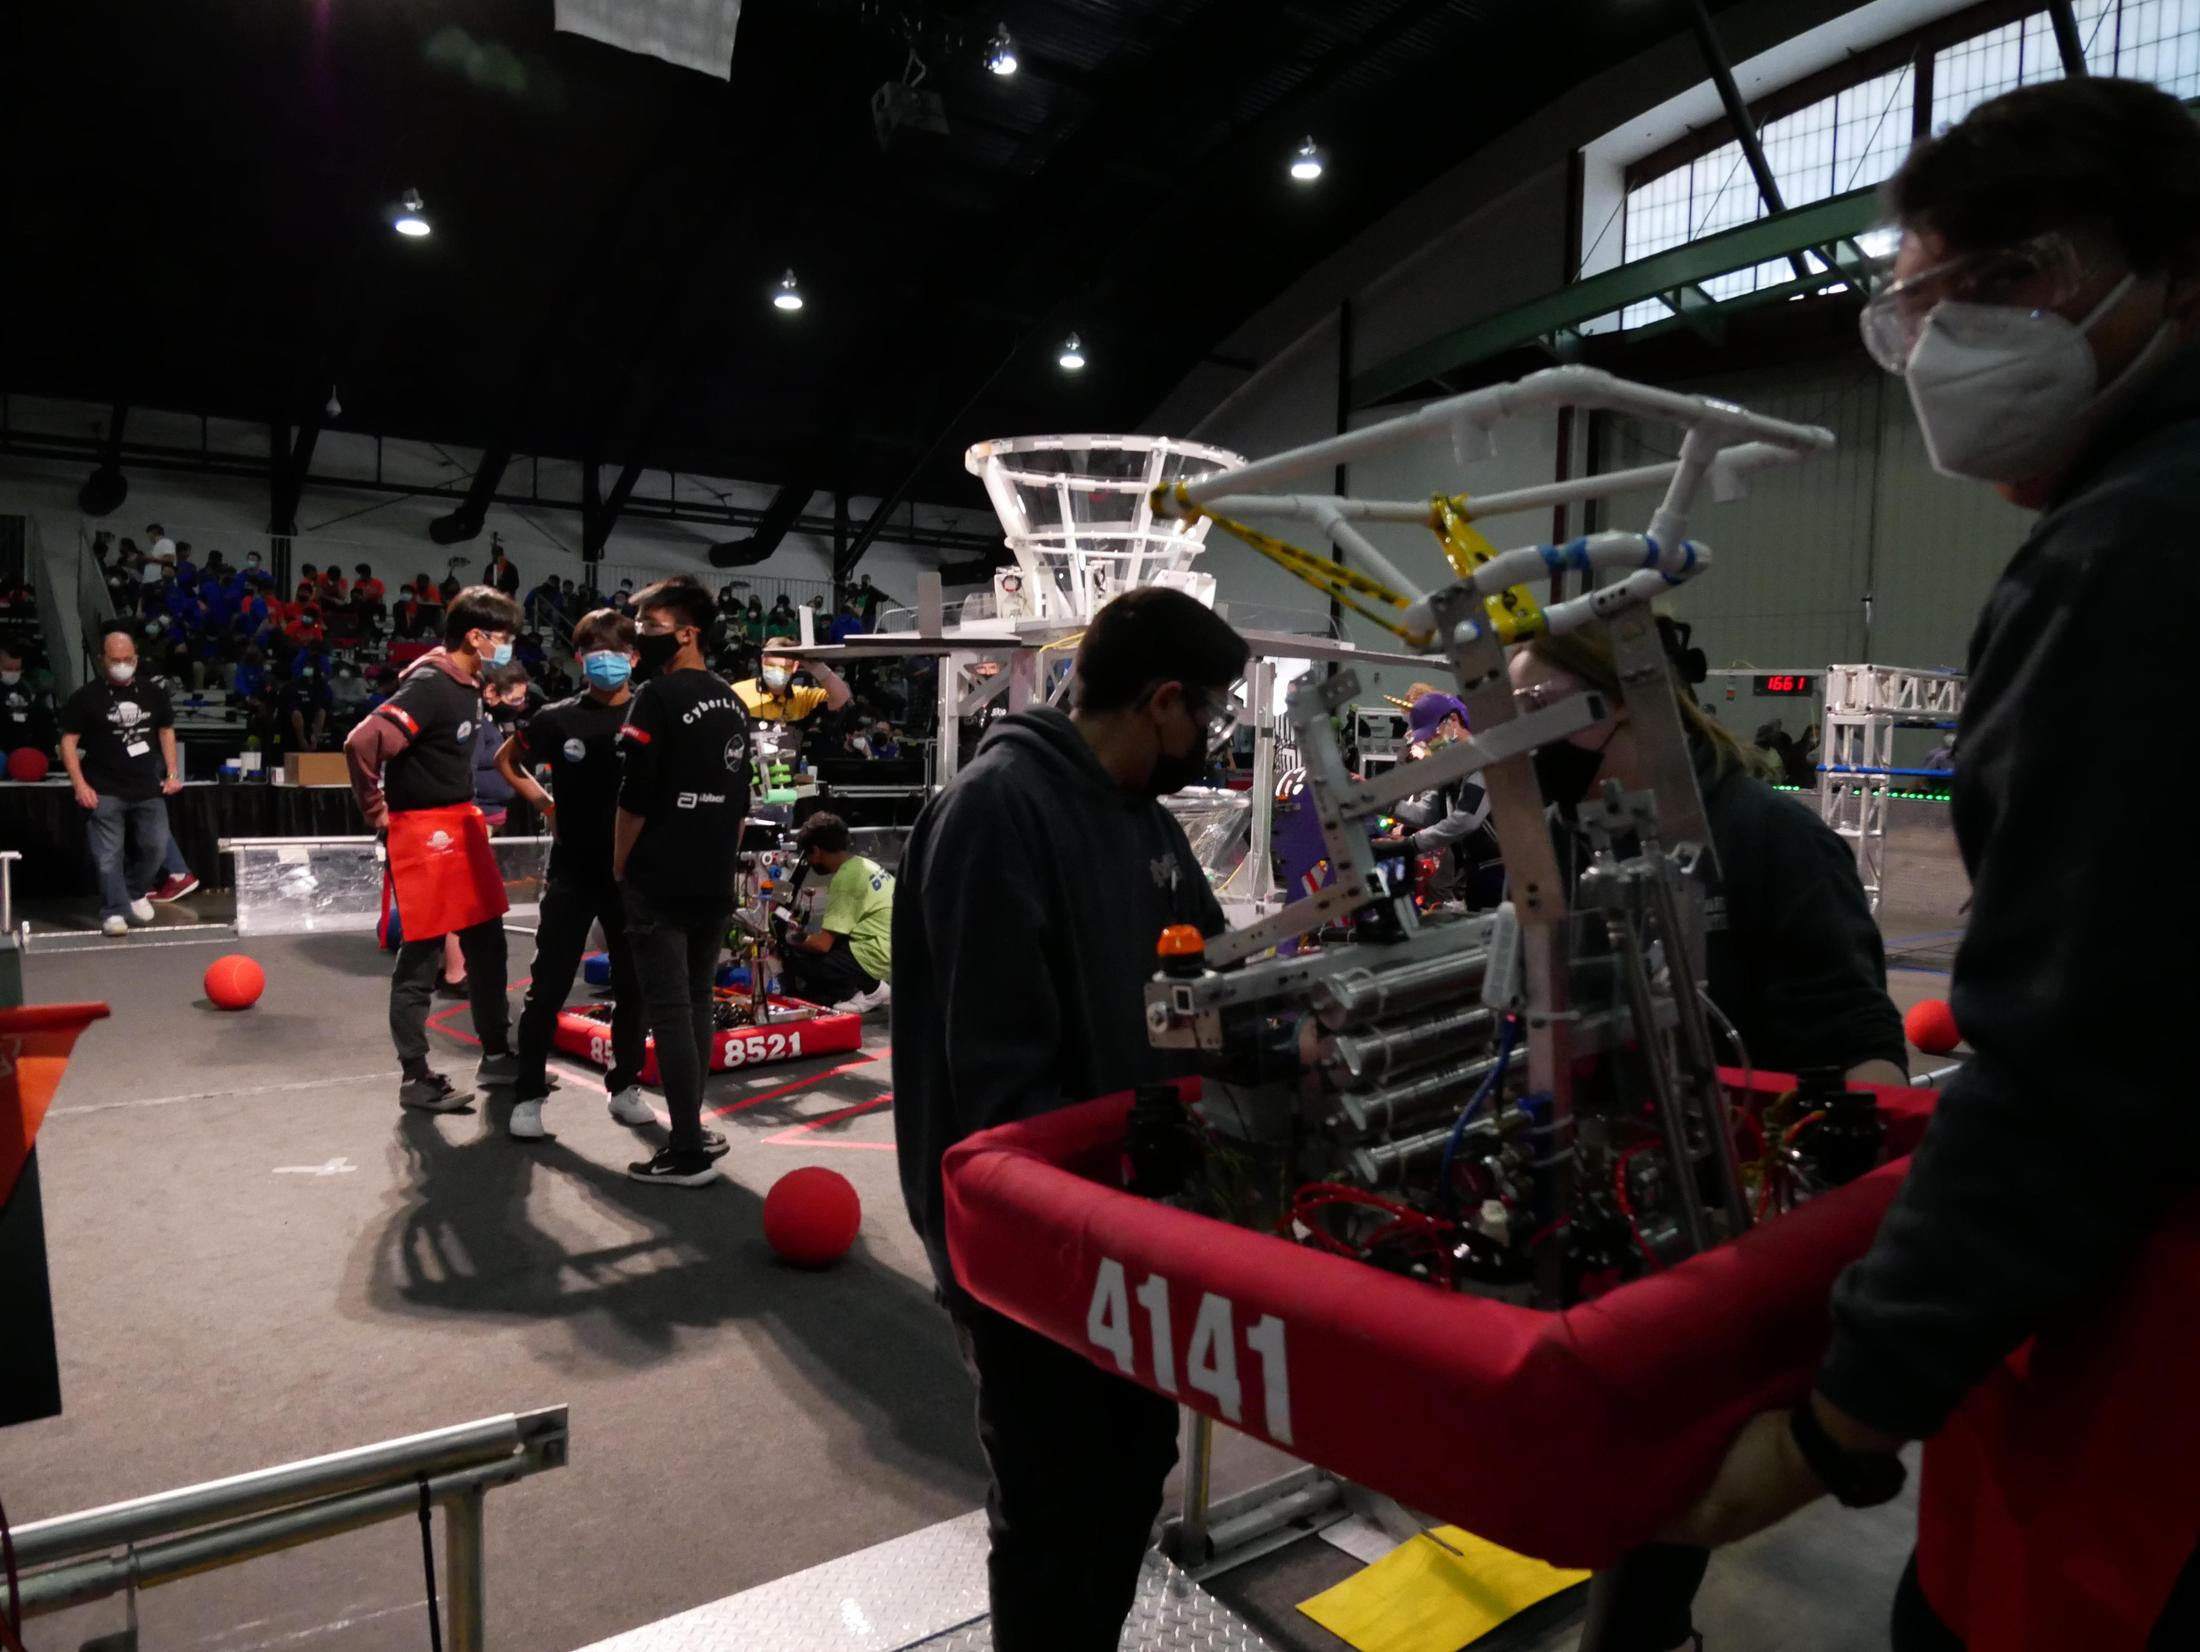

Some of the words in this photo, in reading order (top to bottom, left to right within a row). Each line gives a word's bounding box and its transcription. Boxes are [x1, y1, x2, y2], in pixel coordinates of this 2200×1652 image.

[1767, 675, 1806, 691] 1661
[590, 1036, 613, 1066] 85
[723, 1031, 803, 1068] 8521
[1086, 1256, 1295, 1447] 4141
